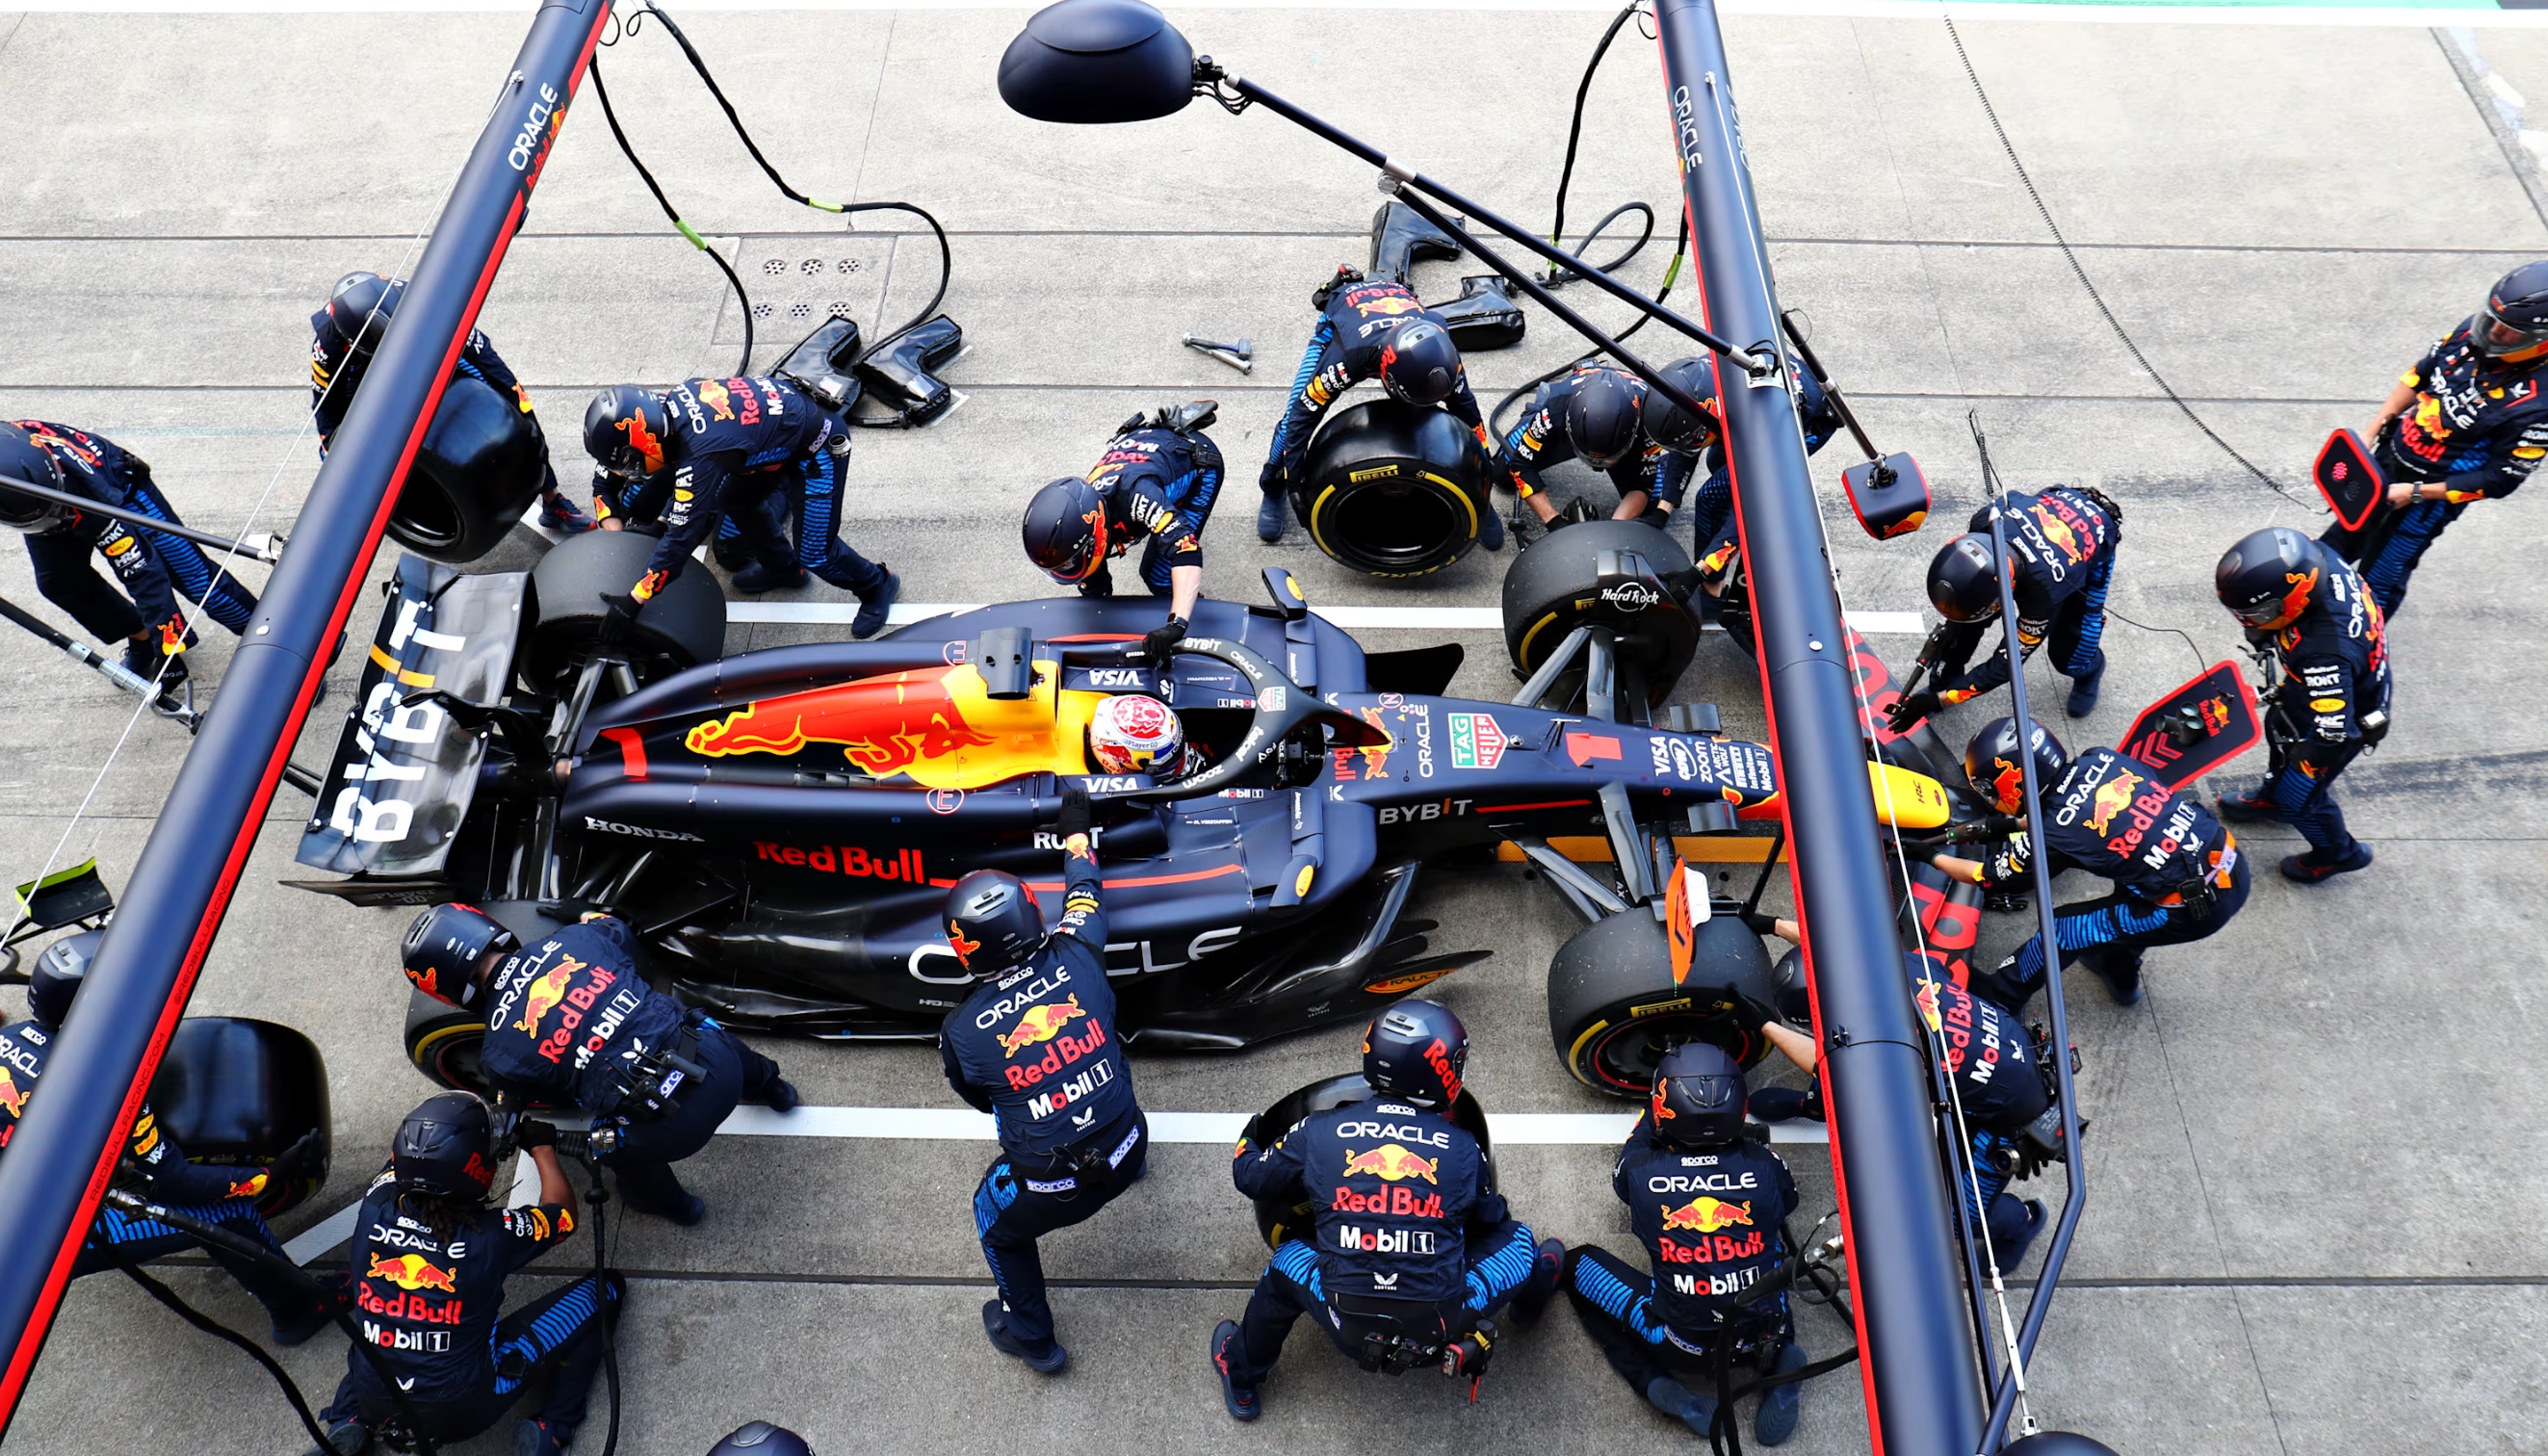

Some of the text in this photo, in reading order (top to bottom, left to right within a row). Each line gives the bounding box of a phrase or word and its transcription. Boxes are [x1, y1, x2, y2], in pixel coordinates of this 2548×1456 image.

[507, 82, 559, 171] ORACLE
[1675, 85, 1703, 173] ORACLE
[1327, 365, 1339, 389] Claro
[1337, 362, 1351, 384] Mobil
[740, 388, 761, 427] Red
[1300, 390, 1318, 411] VISA
[1517, 441, 1535, 461] VISA
[1349, 464, 1399, 483] PIRELLI
[2038, 493, 2097, 562] Red Bull
[2005, 507, 2066, 583] ORACLE
[1600, 587, 1660, 605] Hard Rock
[1183, 637, 1222, 652] BYBIT
[1089, 669, 1144, 687] VISA
[1230, 650, 1264, 681] ORACLE
[2302, 665, 2339, 675] infinitum
[2305, 673, 2341, 688] ROKT
[1217, 698, 1257, 708] Mobil 1
[1274, 688, 1285, 710] TAG
[329, 599, 467, 844] BYBIT
[2198, 699, 2221, 738] Red Bull
[1235, 725, 1264, 763] telcel
[1416, 704, 1433, 778] ORACLE
[1455, 717, 1469, 764] TAG
[1475, 716, 1494, 767] HEUER
[1565, 732, 1623, 767] 1
[1650, 736, 1672, 776] VISA
[1710, 742, 1724, 769] ARCTIC
[1719, 744, 1729, 768] WOLF
[1182, 764, 1226, 790] zoom
[1333, 746, 1357, 781] Bull
[1677, 747, 1691, 781] CDW
[1695, 741, 1713, 784] zoom
[1729, 744, 1748, 789] PIRELLI
[1744, 747, 1760, 790] infinitum
[1754, 748, 1774, 791] Mobil 1
[936, 789, 954, 810] E
[1080, 777, 1138, 793] VISA
[1217, 789, 1263, 799] Mobil 1
[2055, 752, 2116, 826] ORACLE
[1378, 797, 1472, 825] BYBIT
[2106, 780, 2175, 860] Red Bull
[585, 817, 705, 843] HONDA
[1033, 825, 1103, 849] ROT
[2143, 813, 2193, 871] Mobil
[753, 841, 924, 885] Red Bull
[173, 877, 230, 1004] @REDBULLRACING
[490, 940, 562, 1032] ORACLE
[494, 955, 521, 991] sparco
[998, 966, 1035, 991] sparco
[1391, 970, 1451, 986] RAUCH
[537, 965, 617, 1064] Red Bull
[975, 965, 1072, 1030] ORACLE
[1629, 997, 1692, 1018] PIRELLI
[574, 988, 640, 1071] Mobil 1
[0, 1034, 41, 1079] RACL
[1004, 1018, 1106, 1092] Red Bull
[1422, 1037, 1457, 1089] Red
[1969, 1014, 2001, 1085] Mobil
[1027, 1057, 1114, 1121] Mobil 1
[90, 1031, 166, 1203] REDBULLRACING.COM
[1376, 1104, 1417, 1117] sparco
[1108, 1125, 1140, 1170] sparco
[1336, 1121, 1450, 1150] ORACLE
[144, 1141, 166, 1165] VISA
[1680, 1155, 1719, 1166] sparco
[1027, 1177, 1077, 1192] sparco
[1649, 1171, 1758, 1193] ORACLE
[1332, 1183, 1390, 1214] Red
[1391, 1186, 1444, 1219] Bull
[396, 1215, 433, 1235] sparco
[1339, 1225, 1435, 1255] Mobil 1
[1657, 1231, 1766, 1263] Red Bull
[1674, 1265, 1760, 1297] Mobil 1
[357, 1281, 463, 1325] Red Bull
[364, 1320, 451, 1353] Mobil 1
[1664, 1324, 1703, 1356] sparco
